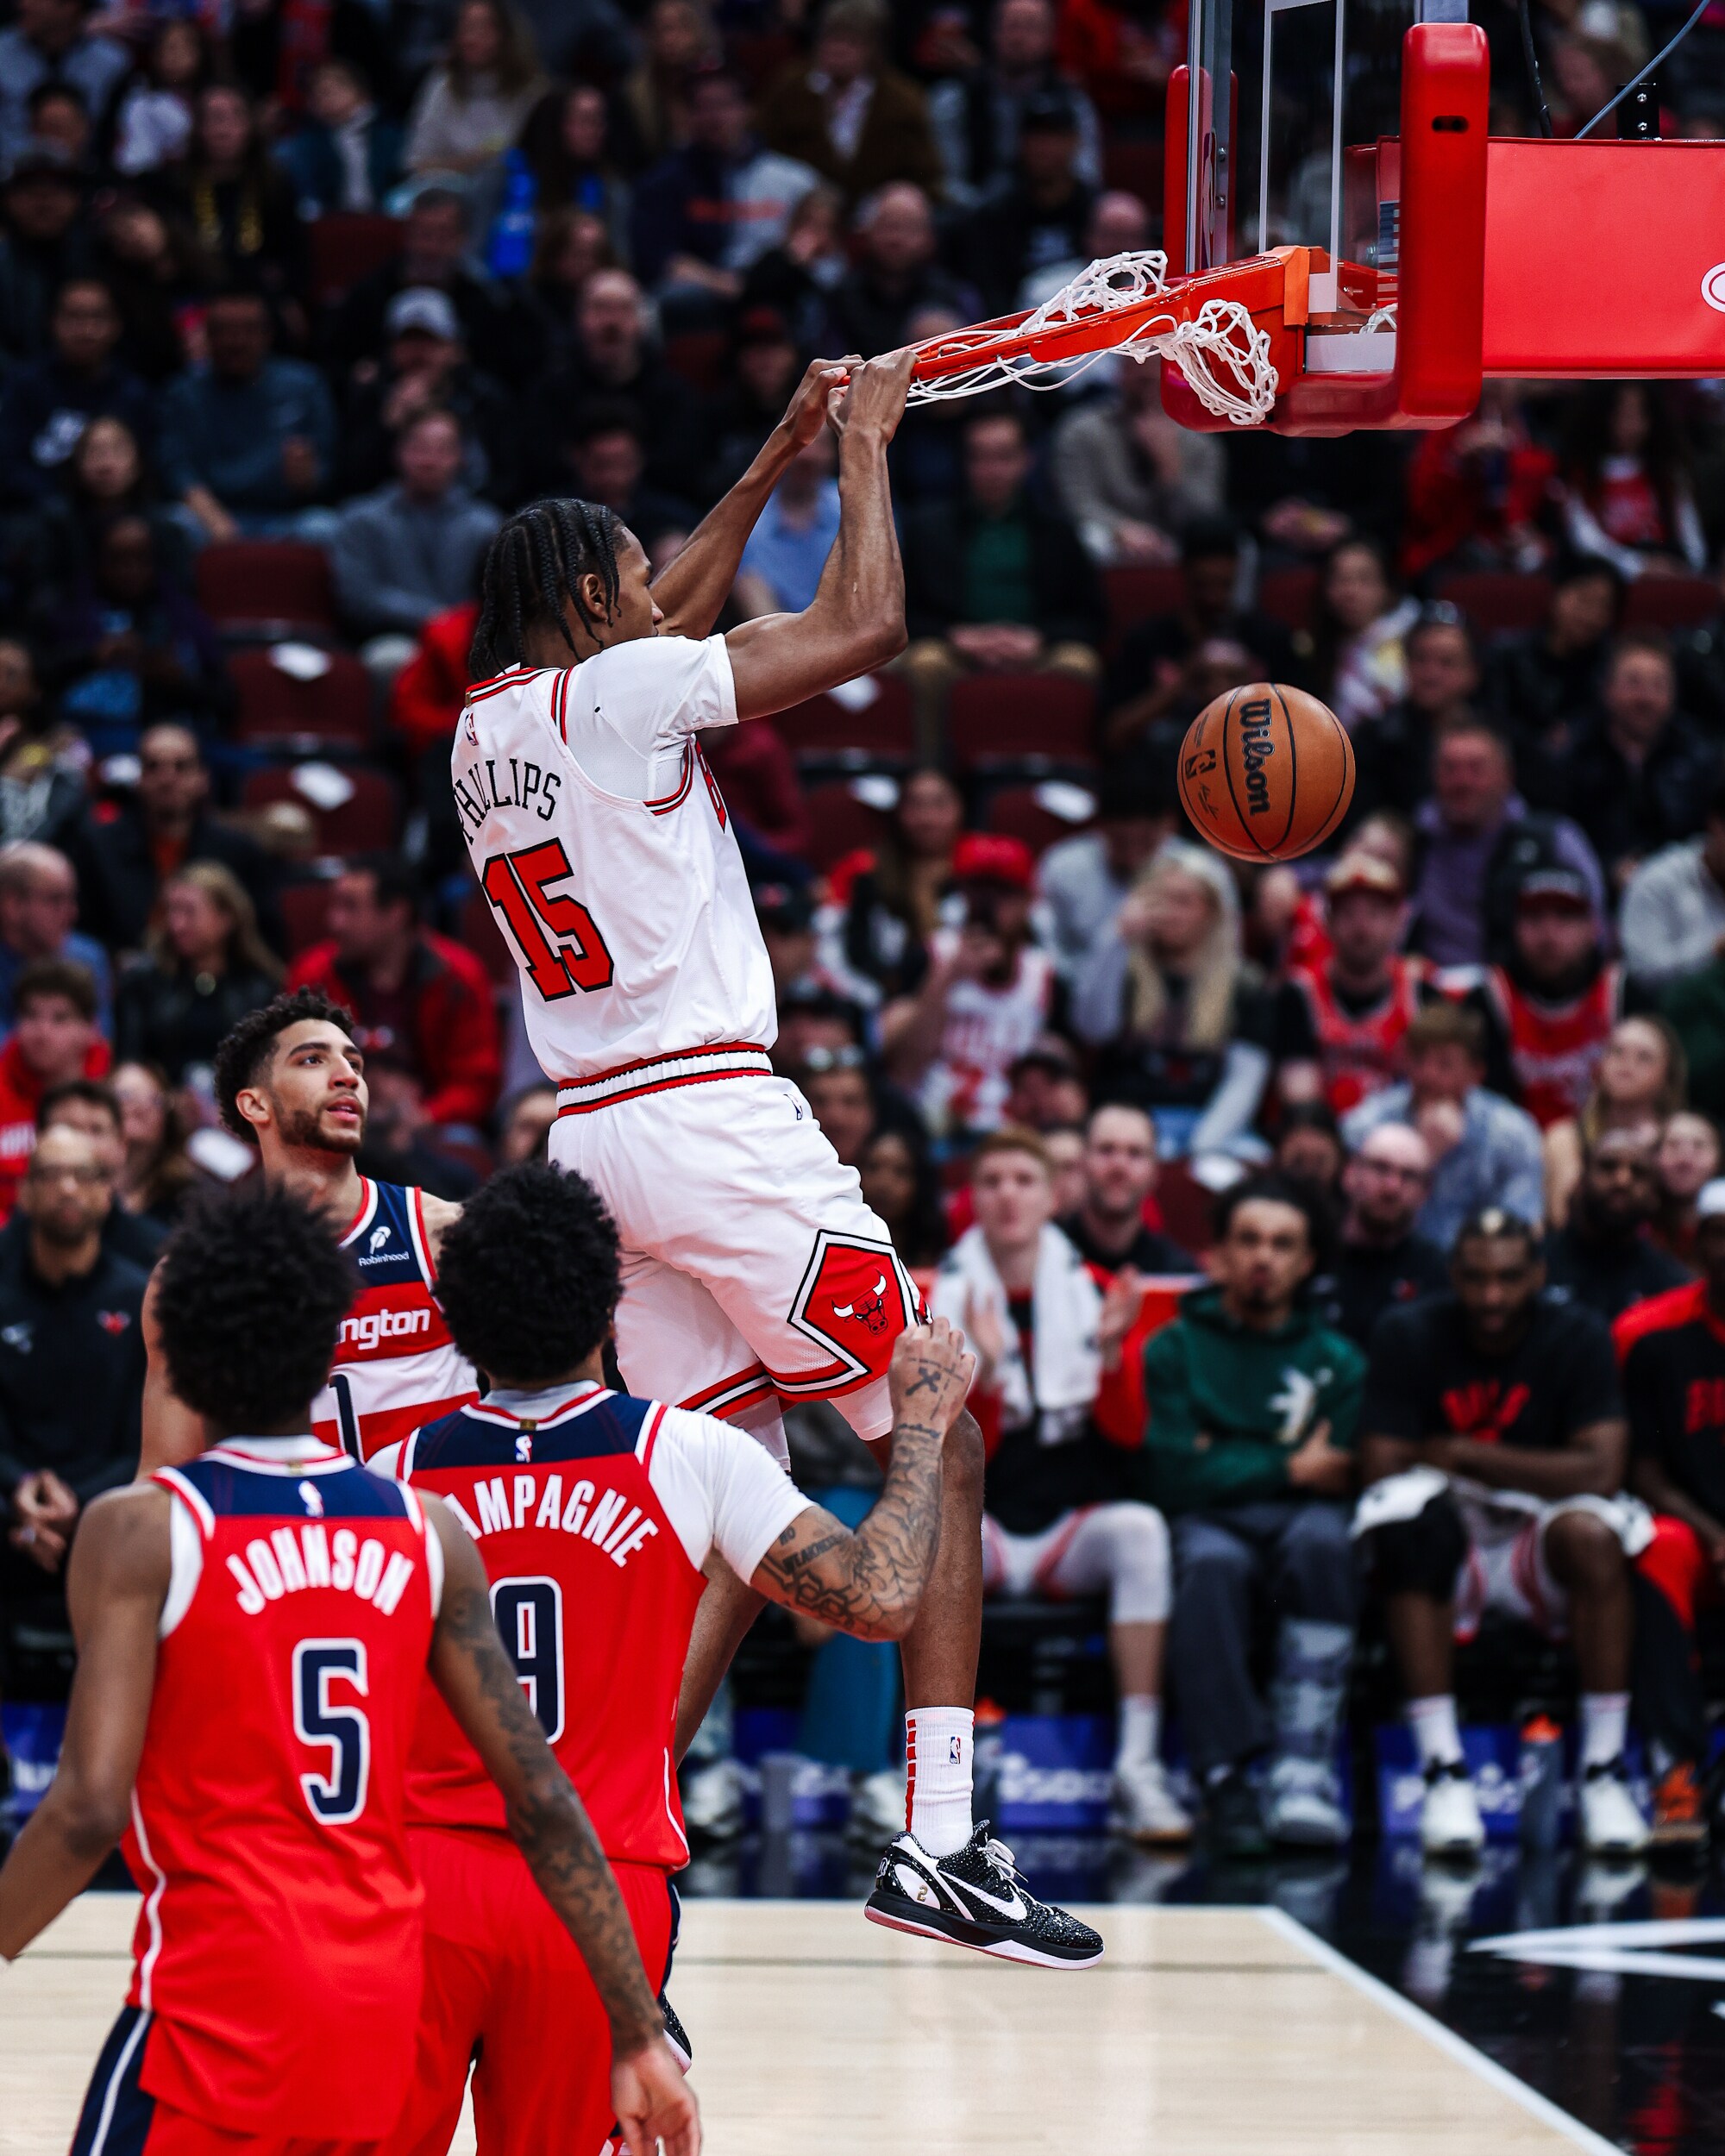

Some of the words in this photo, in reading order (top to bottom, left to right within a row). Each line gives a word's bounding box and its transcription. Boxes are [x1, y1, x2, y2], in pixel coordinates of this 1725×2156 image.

[1239, 698, 1275, 816] Wilson
[481, 837, 614, 1001] 15
[358, 1250, 410, 1267] Robinhood
[336, 1308, 430, 1351] ngton
[442, 1474, 659, 1568] AMPAGNIE
[225, 1524, 416, 1617] JOHNSON
[488, 1575, 565, 1745] 9
[292, 1637, 370, 1826] 5
[917, 1884, 929, 1902] 2
